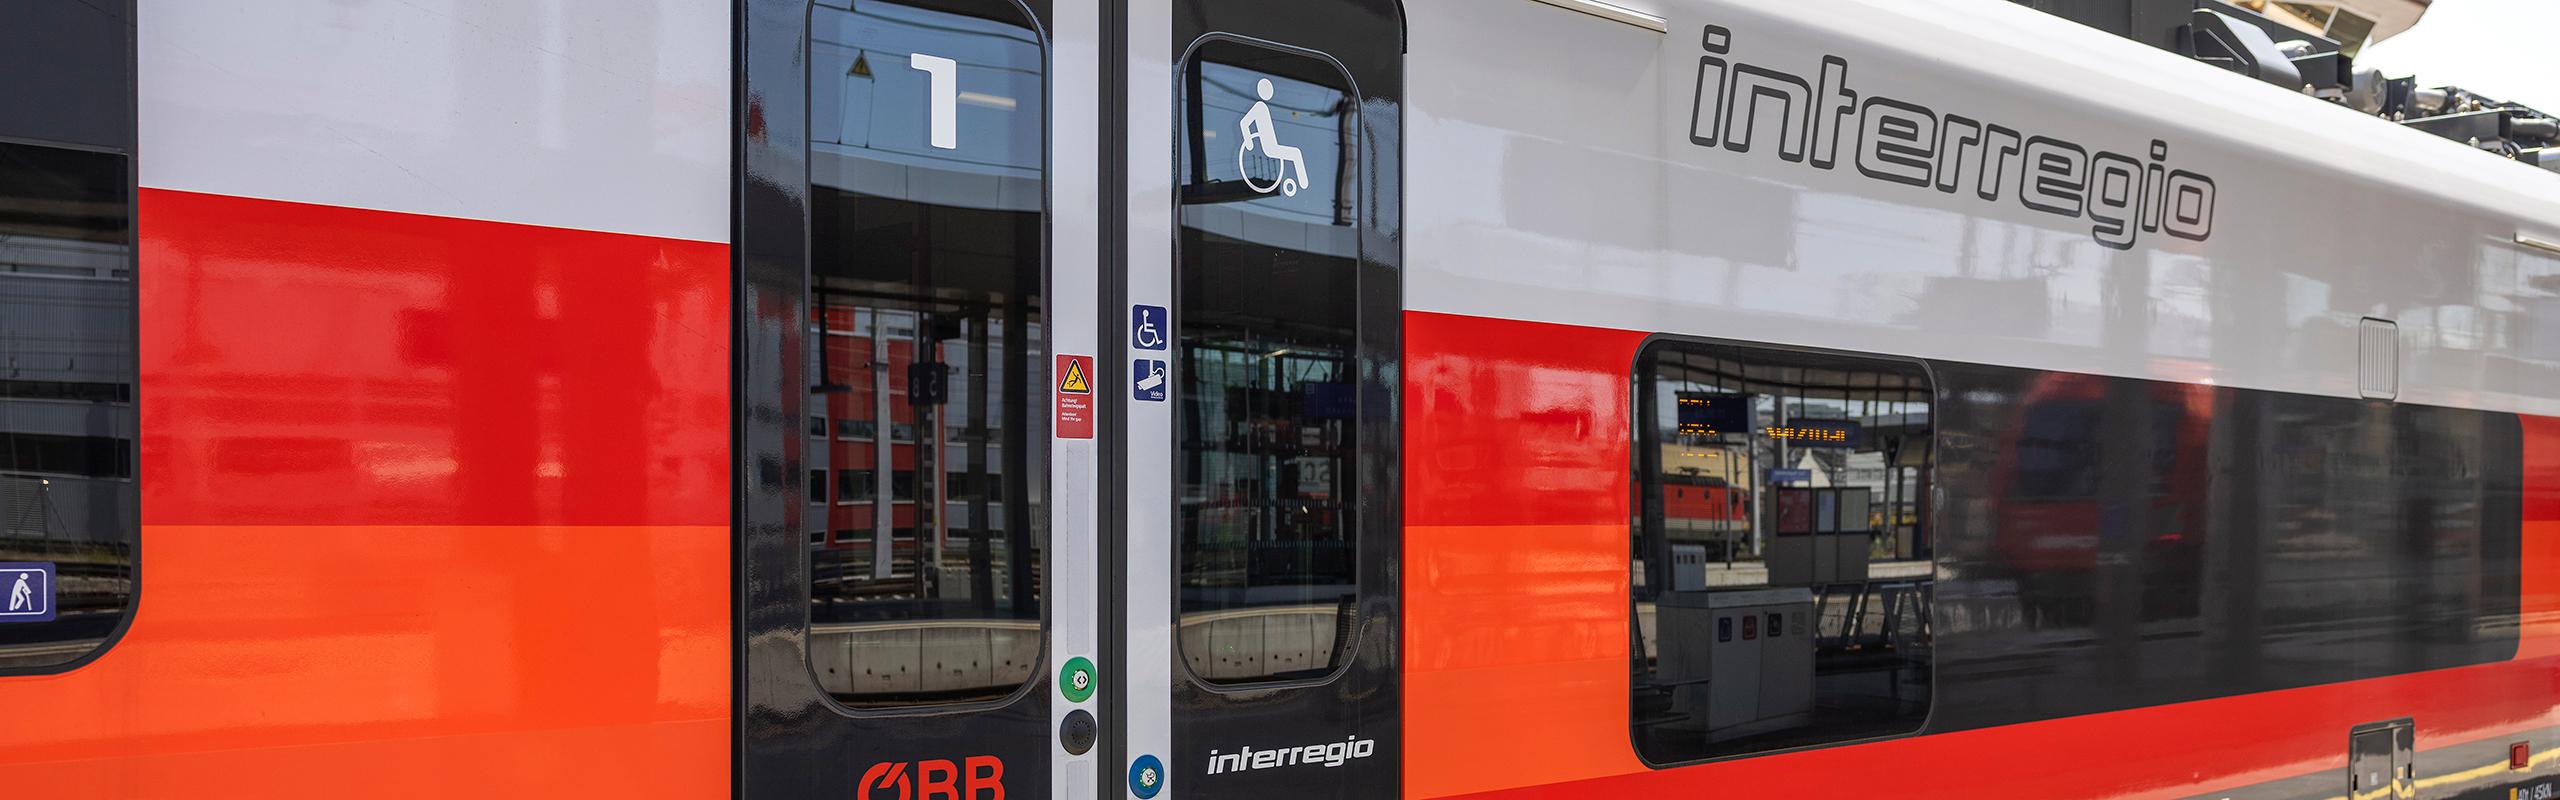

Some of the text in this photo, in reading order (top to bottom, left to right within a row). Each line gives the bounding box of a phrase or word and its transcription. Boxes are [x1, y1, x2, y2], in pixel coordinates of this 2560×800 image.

[910, 53, 957, 150] 1
[1689, 24, 2215, 250] interregio
[857, 755, 1005, 800] ÖBB
[1207, 735, 1375, 775] interregio
